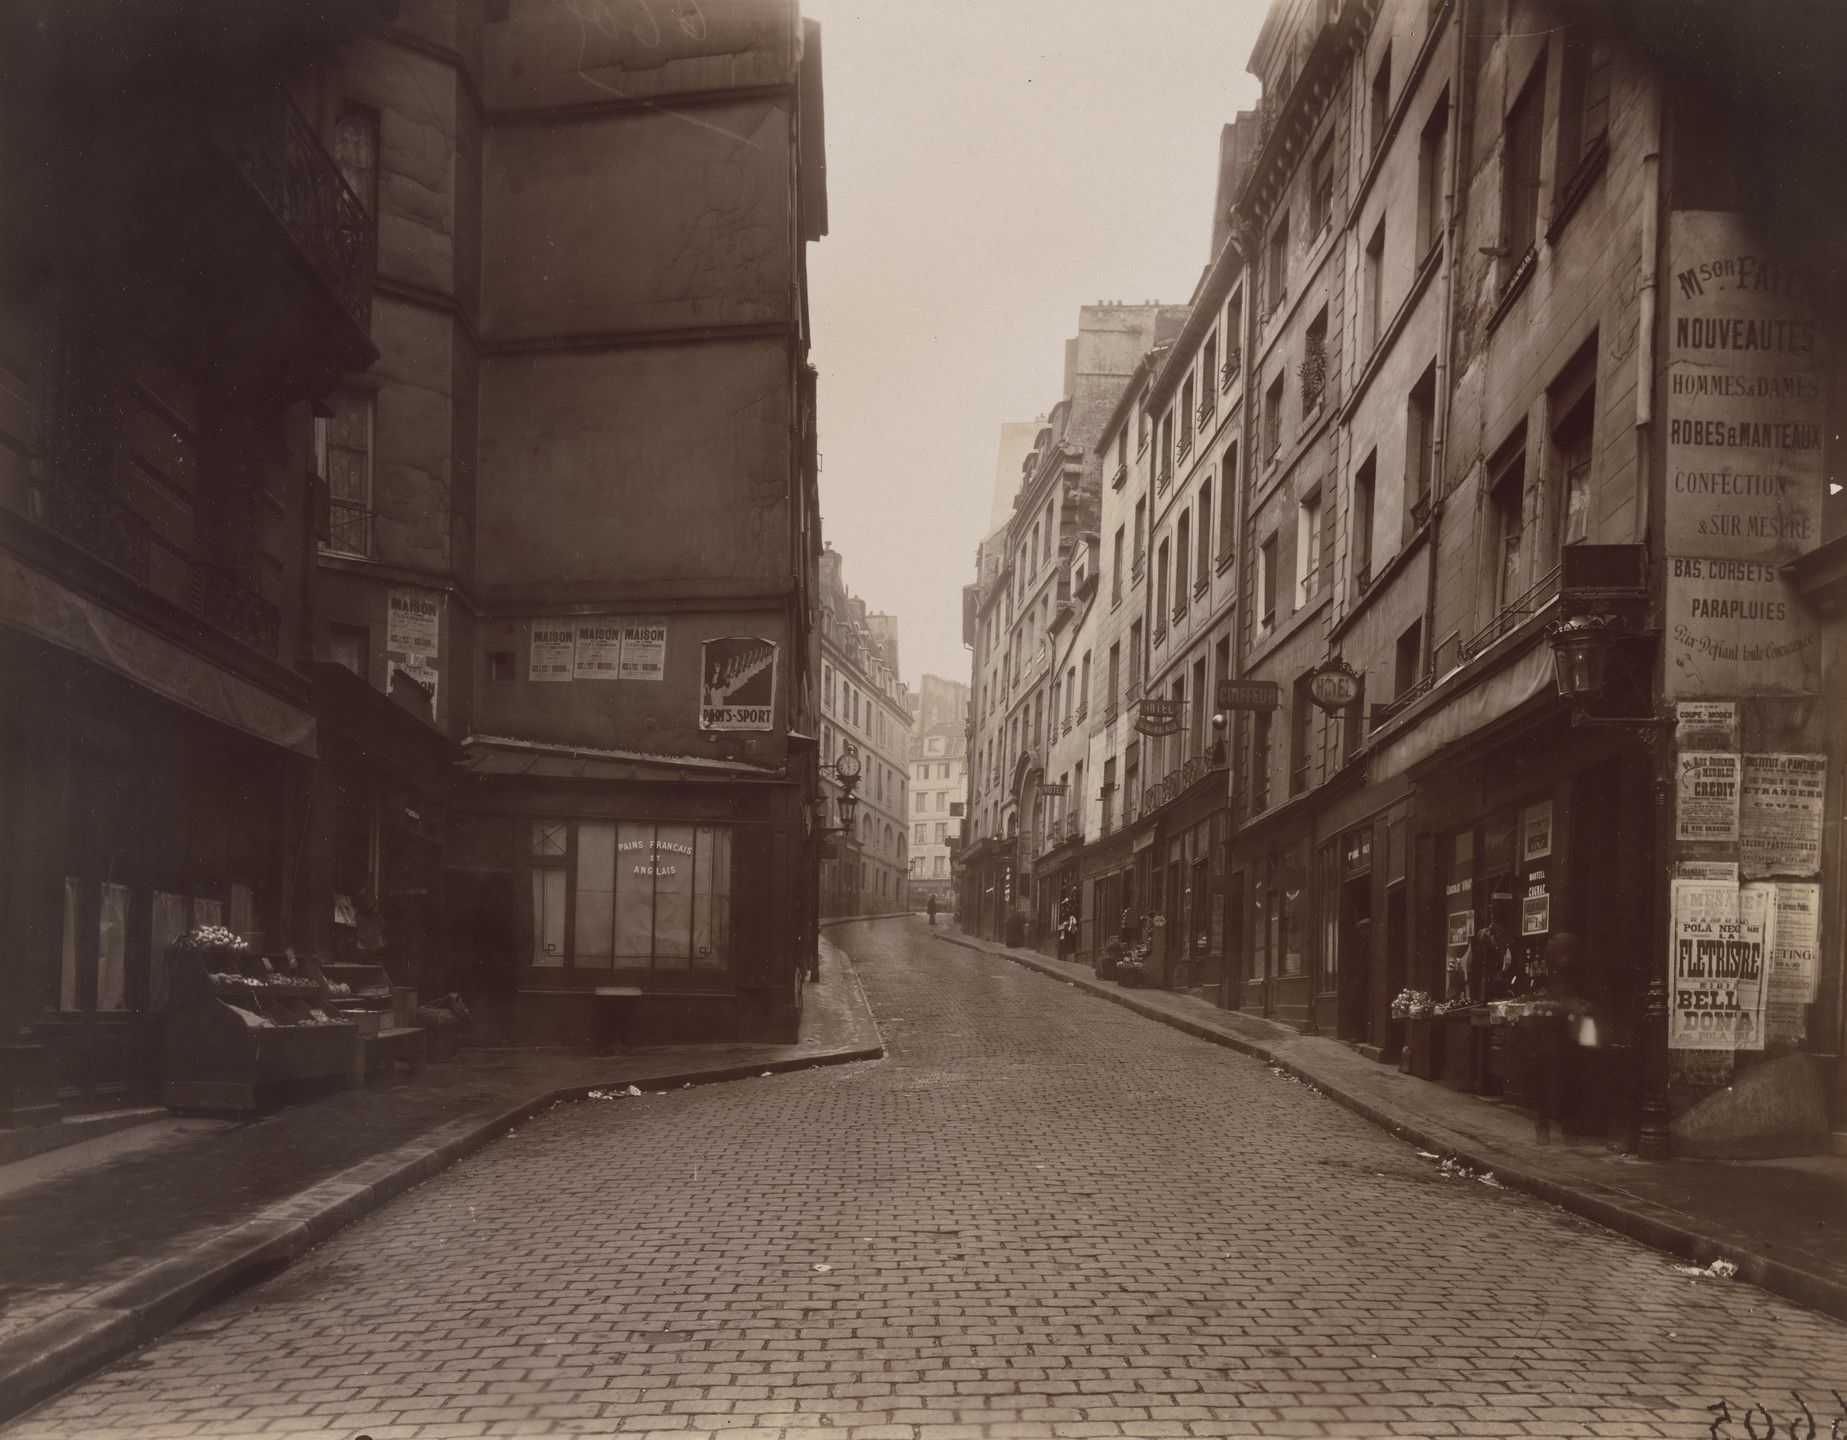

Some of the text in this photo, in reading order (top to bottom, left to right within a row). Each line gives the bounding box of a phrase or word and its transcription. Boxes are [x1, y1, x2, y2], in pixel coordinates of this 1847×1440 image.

[1747, 516, 1811, 539] MESURE
[1709, 562, 1774, 583] CORSETS
[391, 598, 436, 616] MAISON
[1692, 598, 1786, 621] PARAPLUIES
[534, 631, 573, 643] MAISON
[579, 629, 619, 640] MAISON
[625, 629, 664, 641] MAISON
[618, 841, 643, 851] PAINS
[633, 865, 676, 875] ANGLAIS
[1684, 924, 1713, 933] POLA
